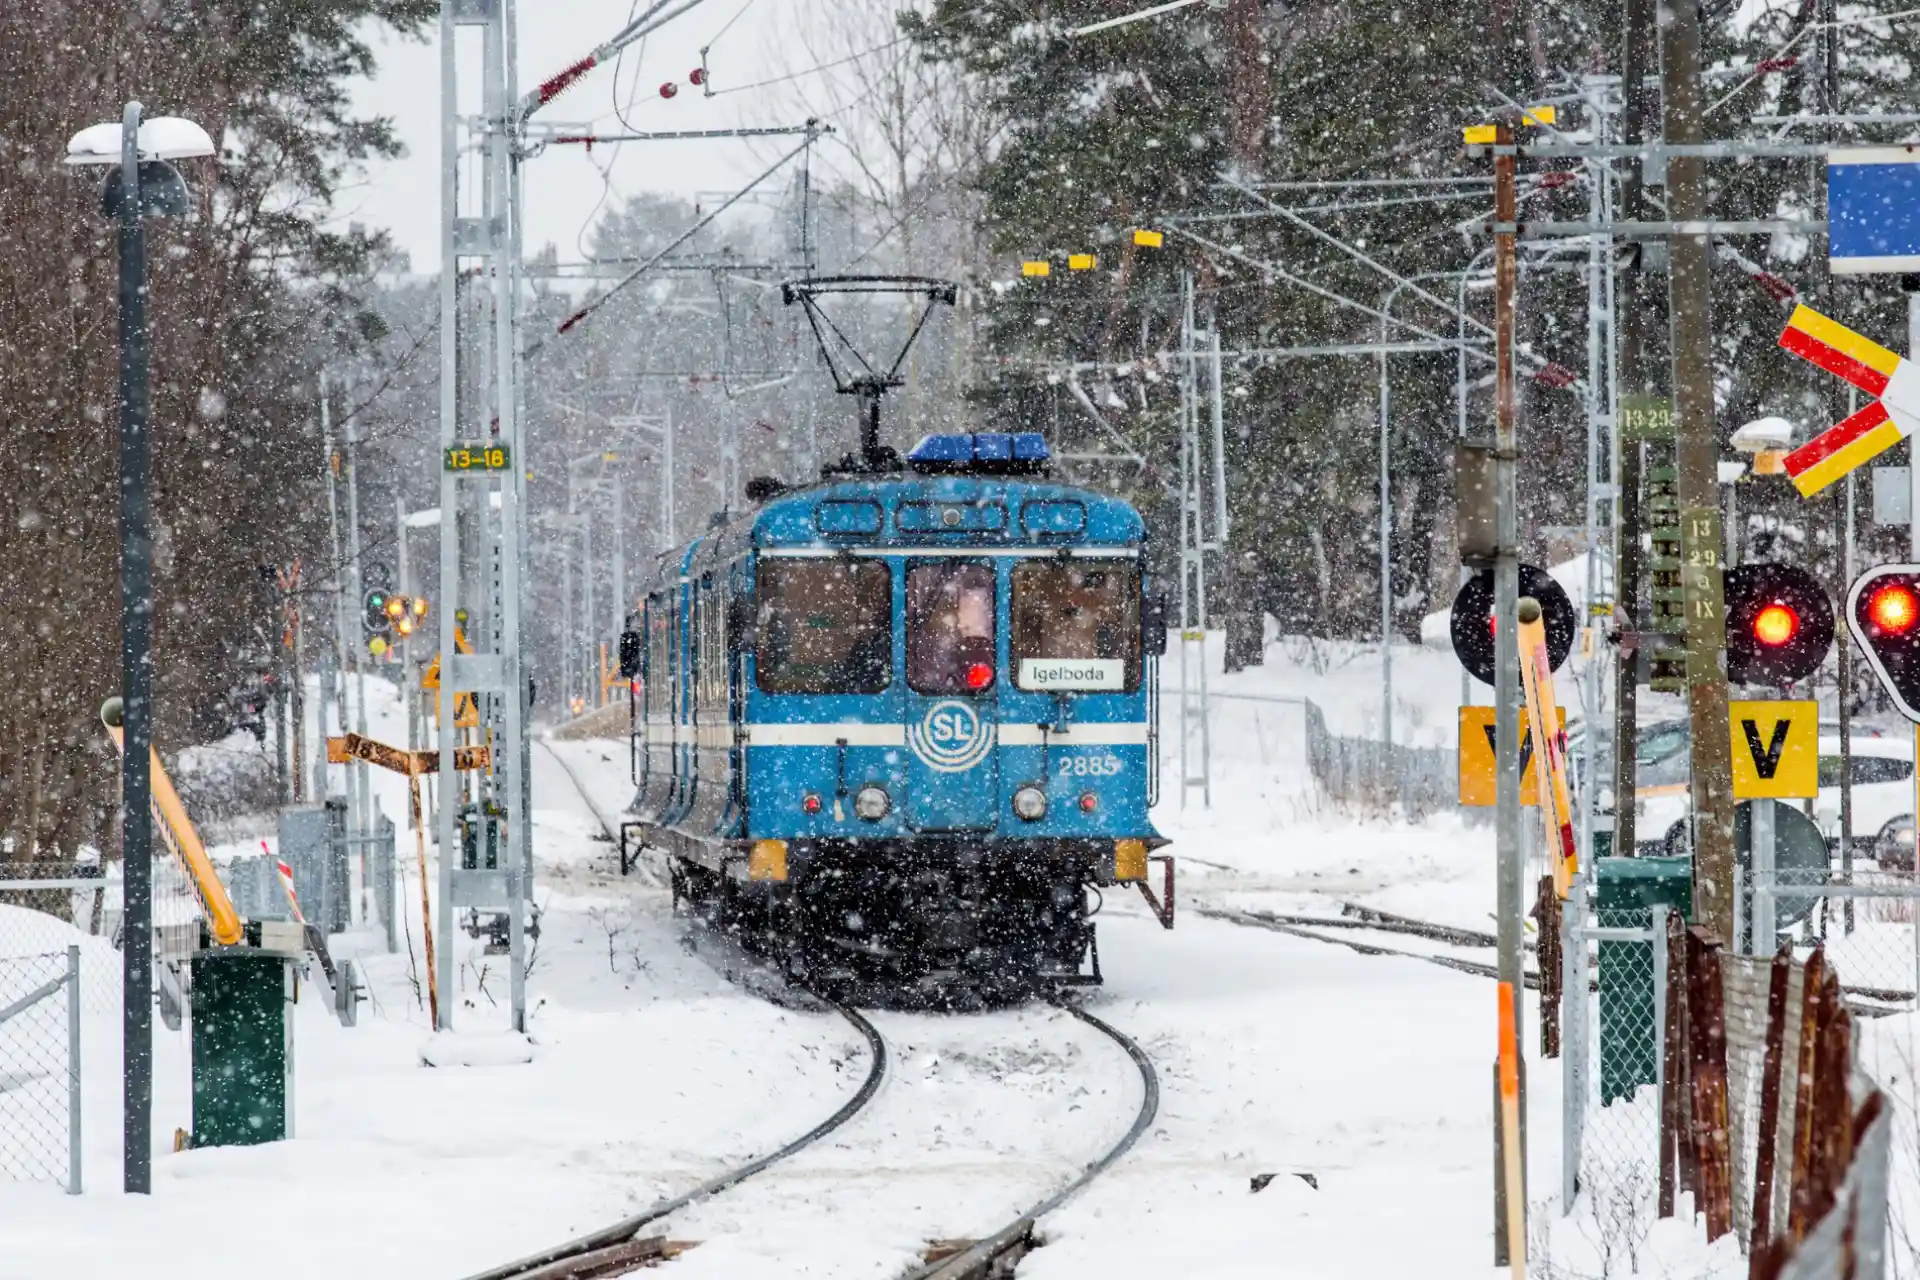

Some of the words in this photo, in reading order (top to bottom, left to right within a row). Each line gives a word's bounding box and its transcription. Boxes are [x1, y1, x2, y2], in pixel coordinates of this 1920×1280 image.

[1692, 519, 1711, 537] 13
[1689, 549, 1716, 567] 29
[1033, 666, 1104, 682] Igelboda
[934, 713, 972, 740] SL
[1741, 719, 1790, 779] V
[1059, 755, 1119, 776] 2885
